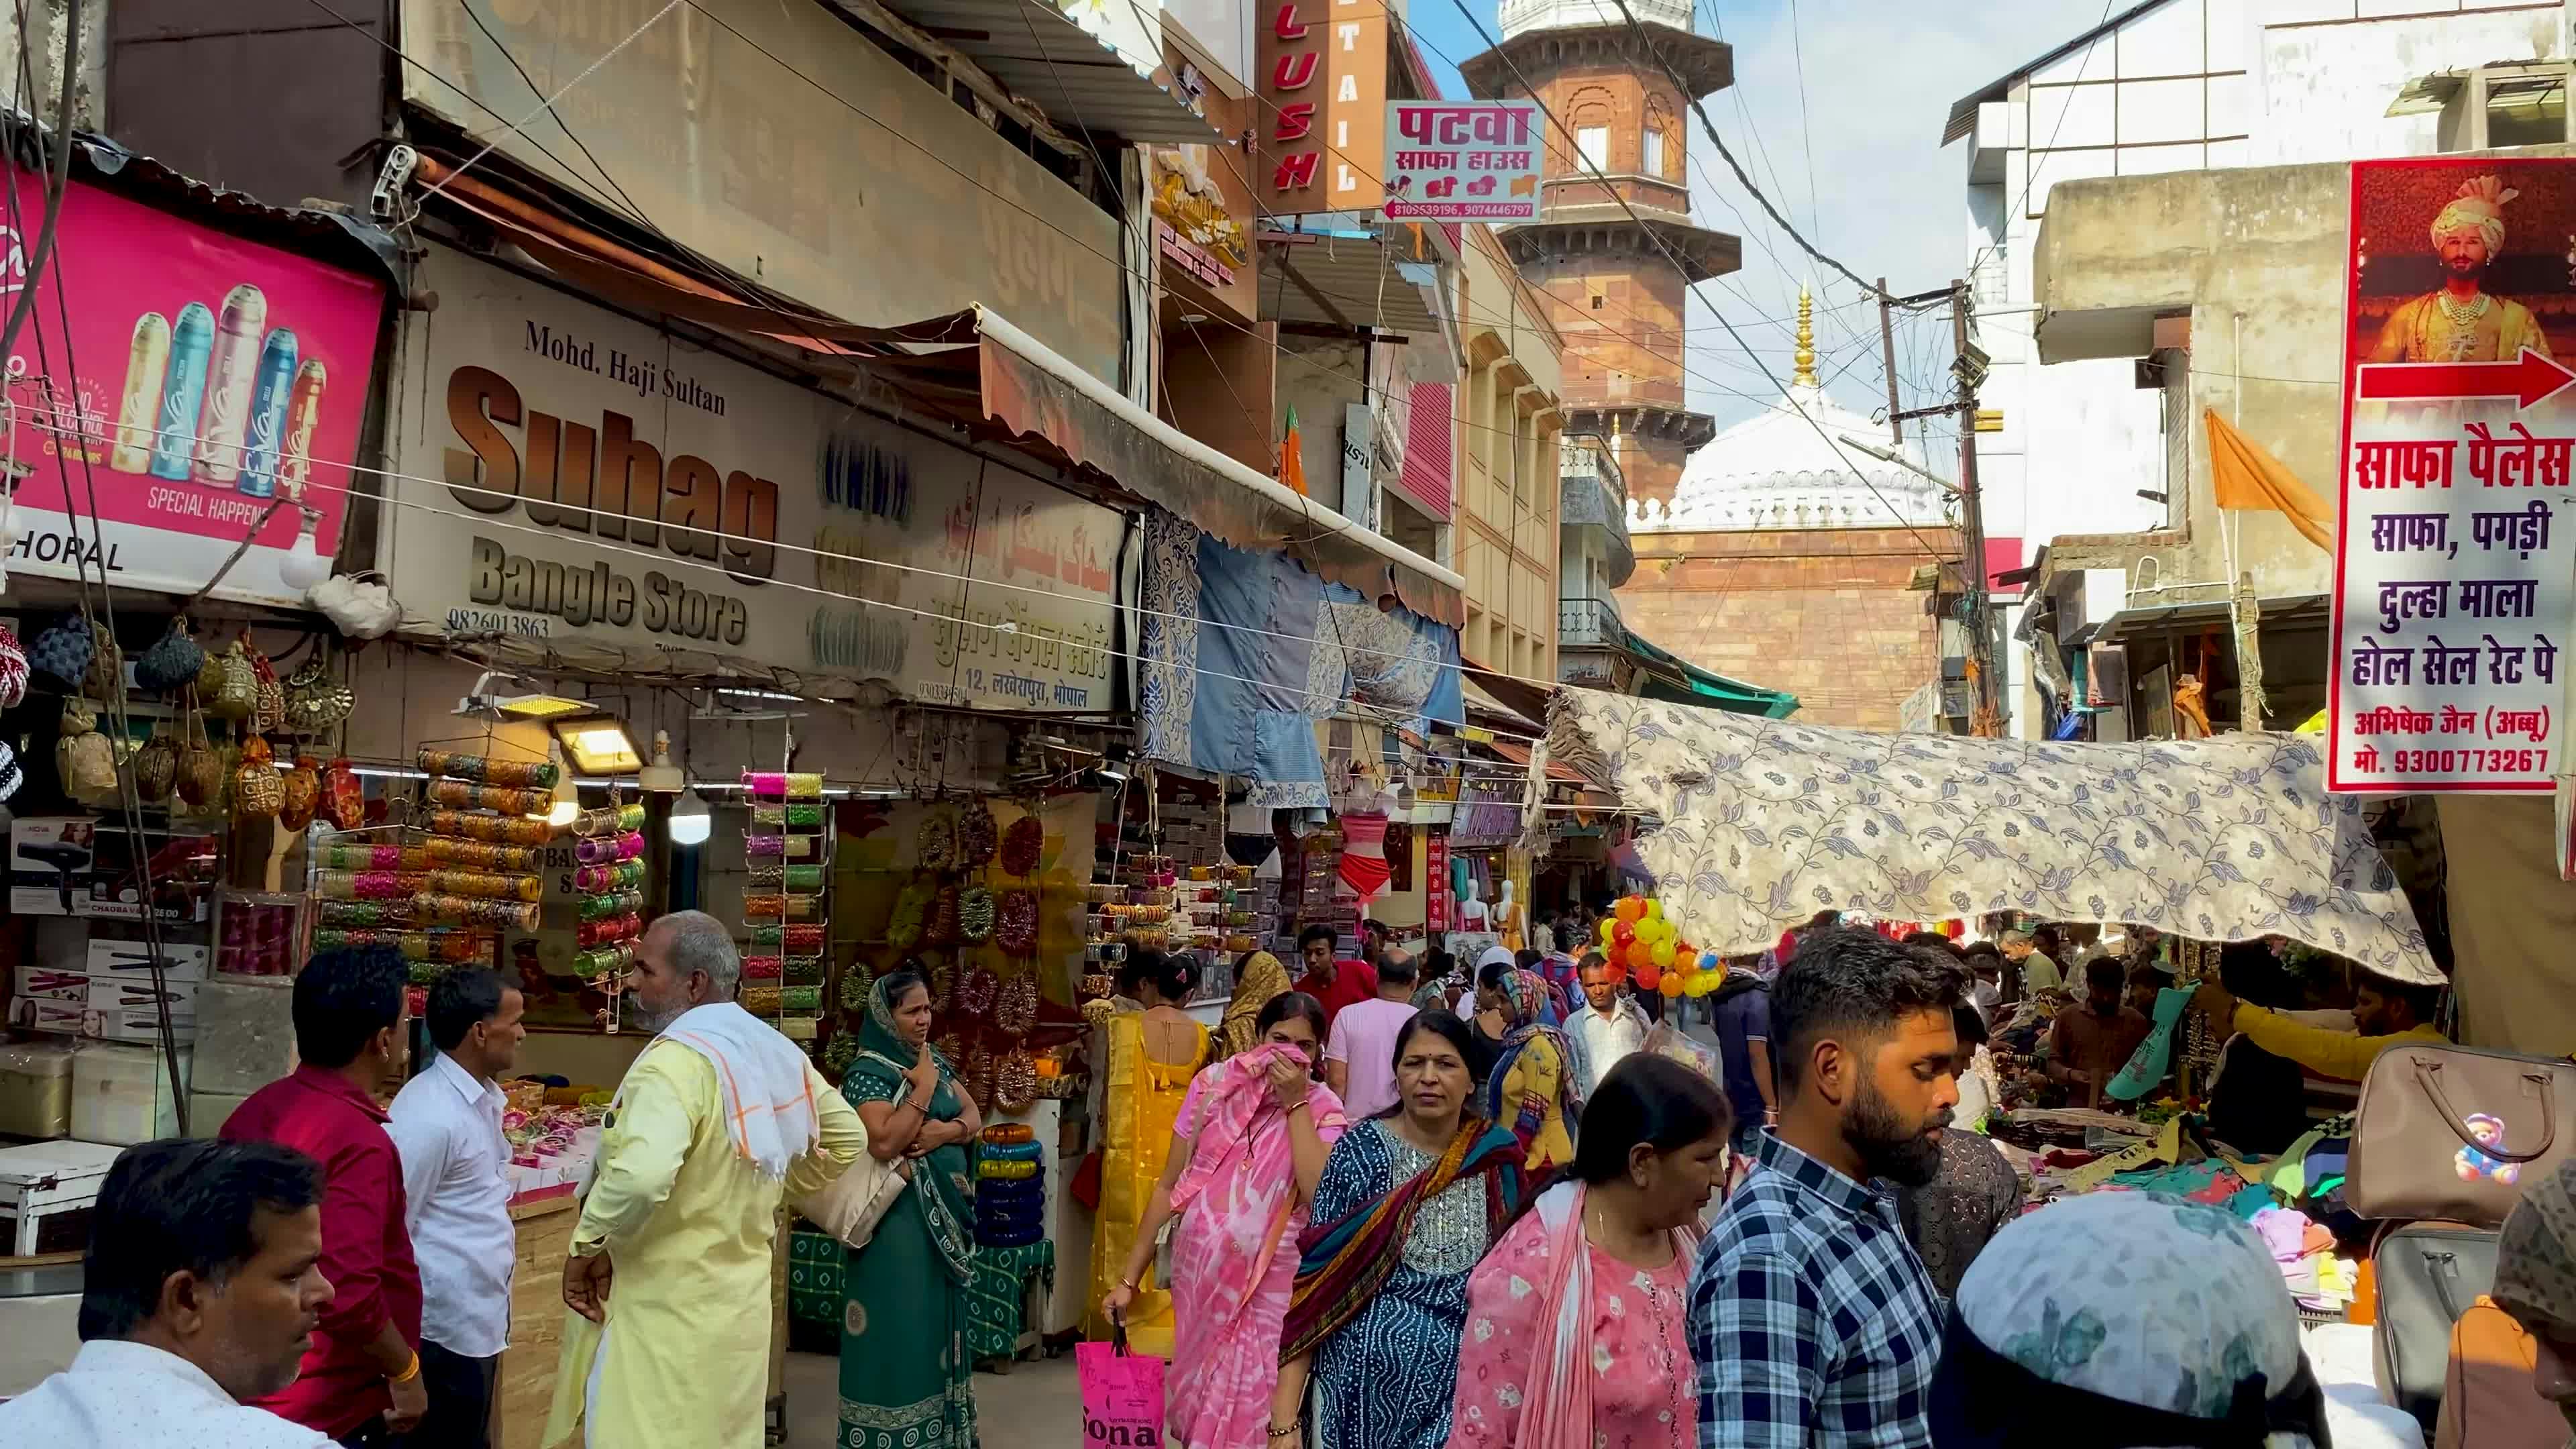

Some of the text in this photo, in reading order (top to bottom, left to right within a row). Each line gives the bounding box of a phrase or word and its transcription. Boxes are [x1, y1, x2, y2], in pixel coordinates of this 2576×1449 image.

[1337, 0, 1360, 192] TAIL
[1397, 108, 1535, 146] पटवा
[1395, 152, 1533, 170] साफा हाउस
[1464, 203, 1532, 215] 9074446797
[525, 321, 726, 417] Mohd. Haji Sultan
[443, 366, 780, 586] Suhag
[2355, 422, 2575, 489] साफा पैलेस
[148, 486, 204, 518] SPECIAL
[2371, 500, 2553, 560] साफा, पगड़ी
[470, 536, 747, 646] Bangle Store
[2378, 580, 2538, 634] दुल्हा माला
[2352, 634, 2558, 686] होल सेल रेट पे
[966, 667, 987, 696] 12,
[1054, 678, 1088, 708] भोपाल
[2354, 704, 2551, 743] अभिषेक जैन (अब्बू)
[2353, 743, 2549, 774] मो. 9300773267
